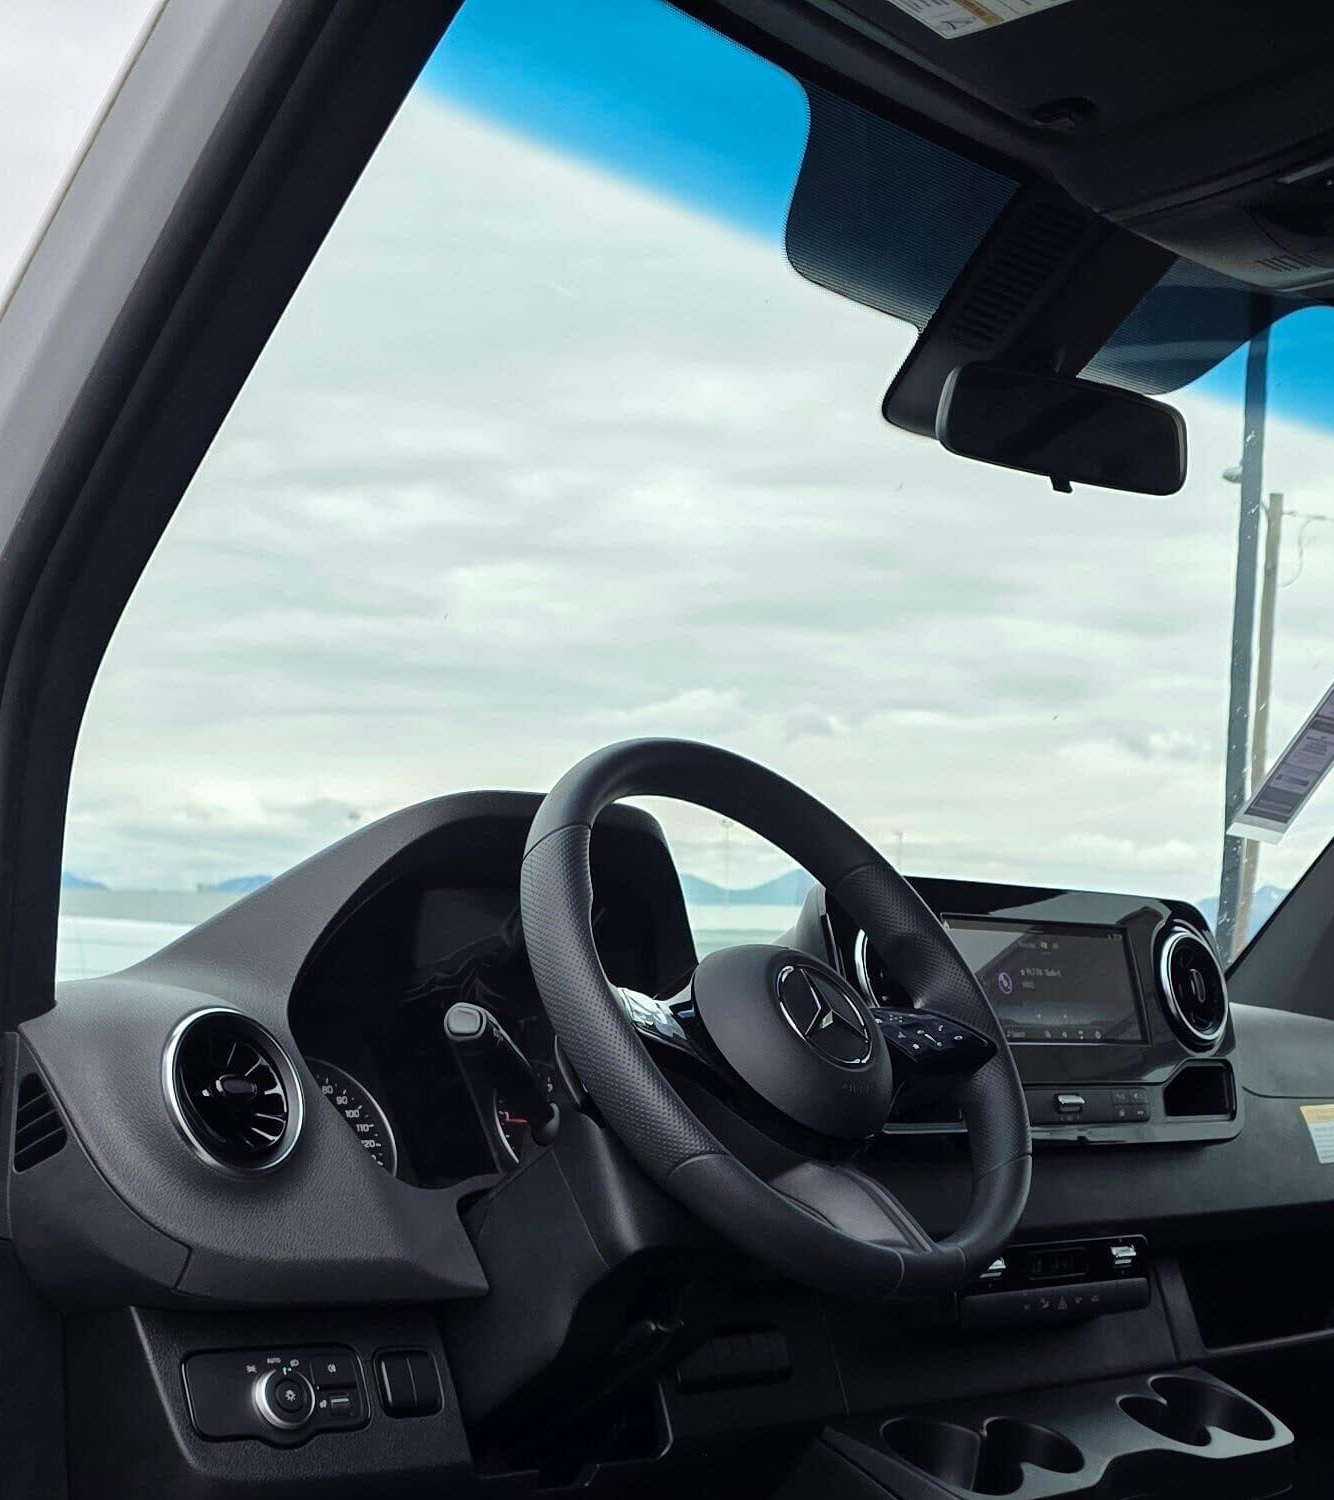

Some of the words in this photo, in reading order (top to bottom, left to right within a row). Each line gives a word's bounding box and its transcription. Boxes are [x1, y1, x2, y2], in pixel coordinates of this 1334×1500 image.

[336, 1096, 348, 1105] 90
[345, 1109, 359, 1118] 100
[356, 1124, 369, 1132] 110
